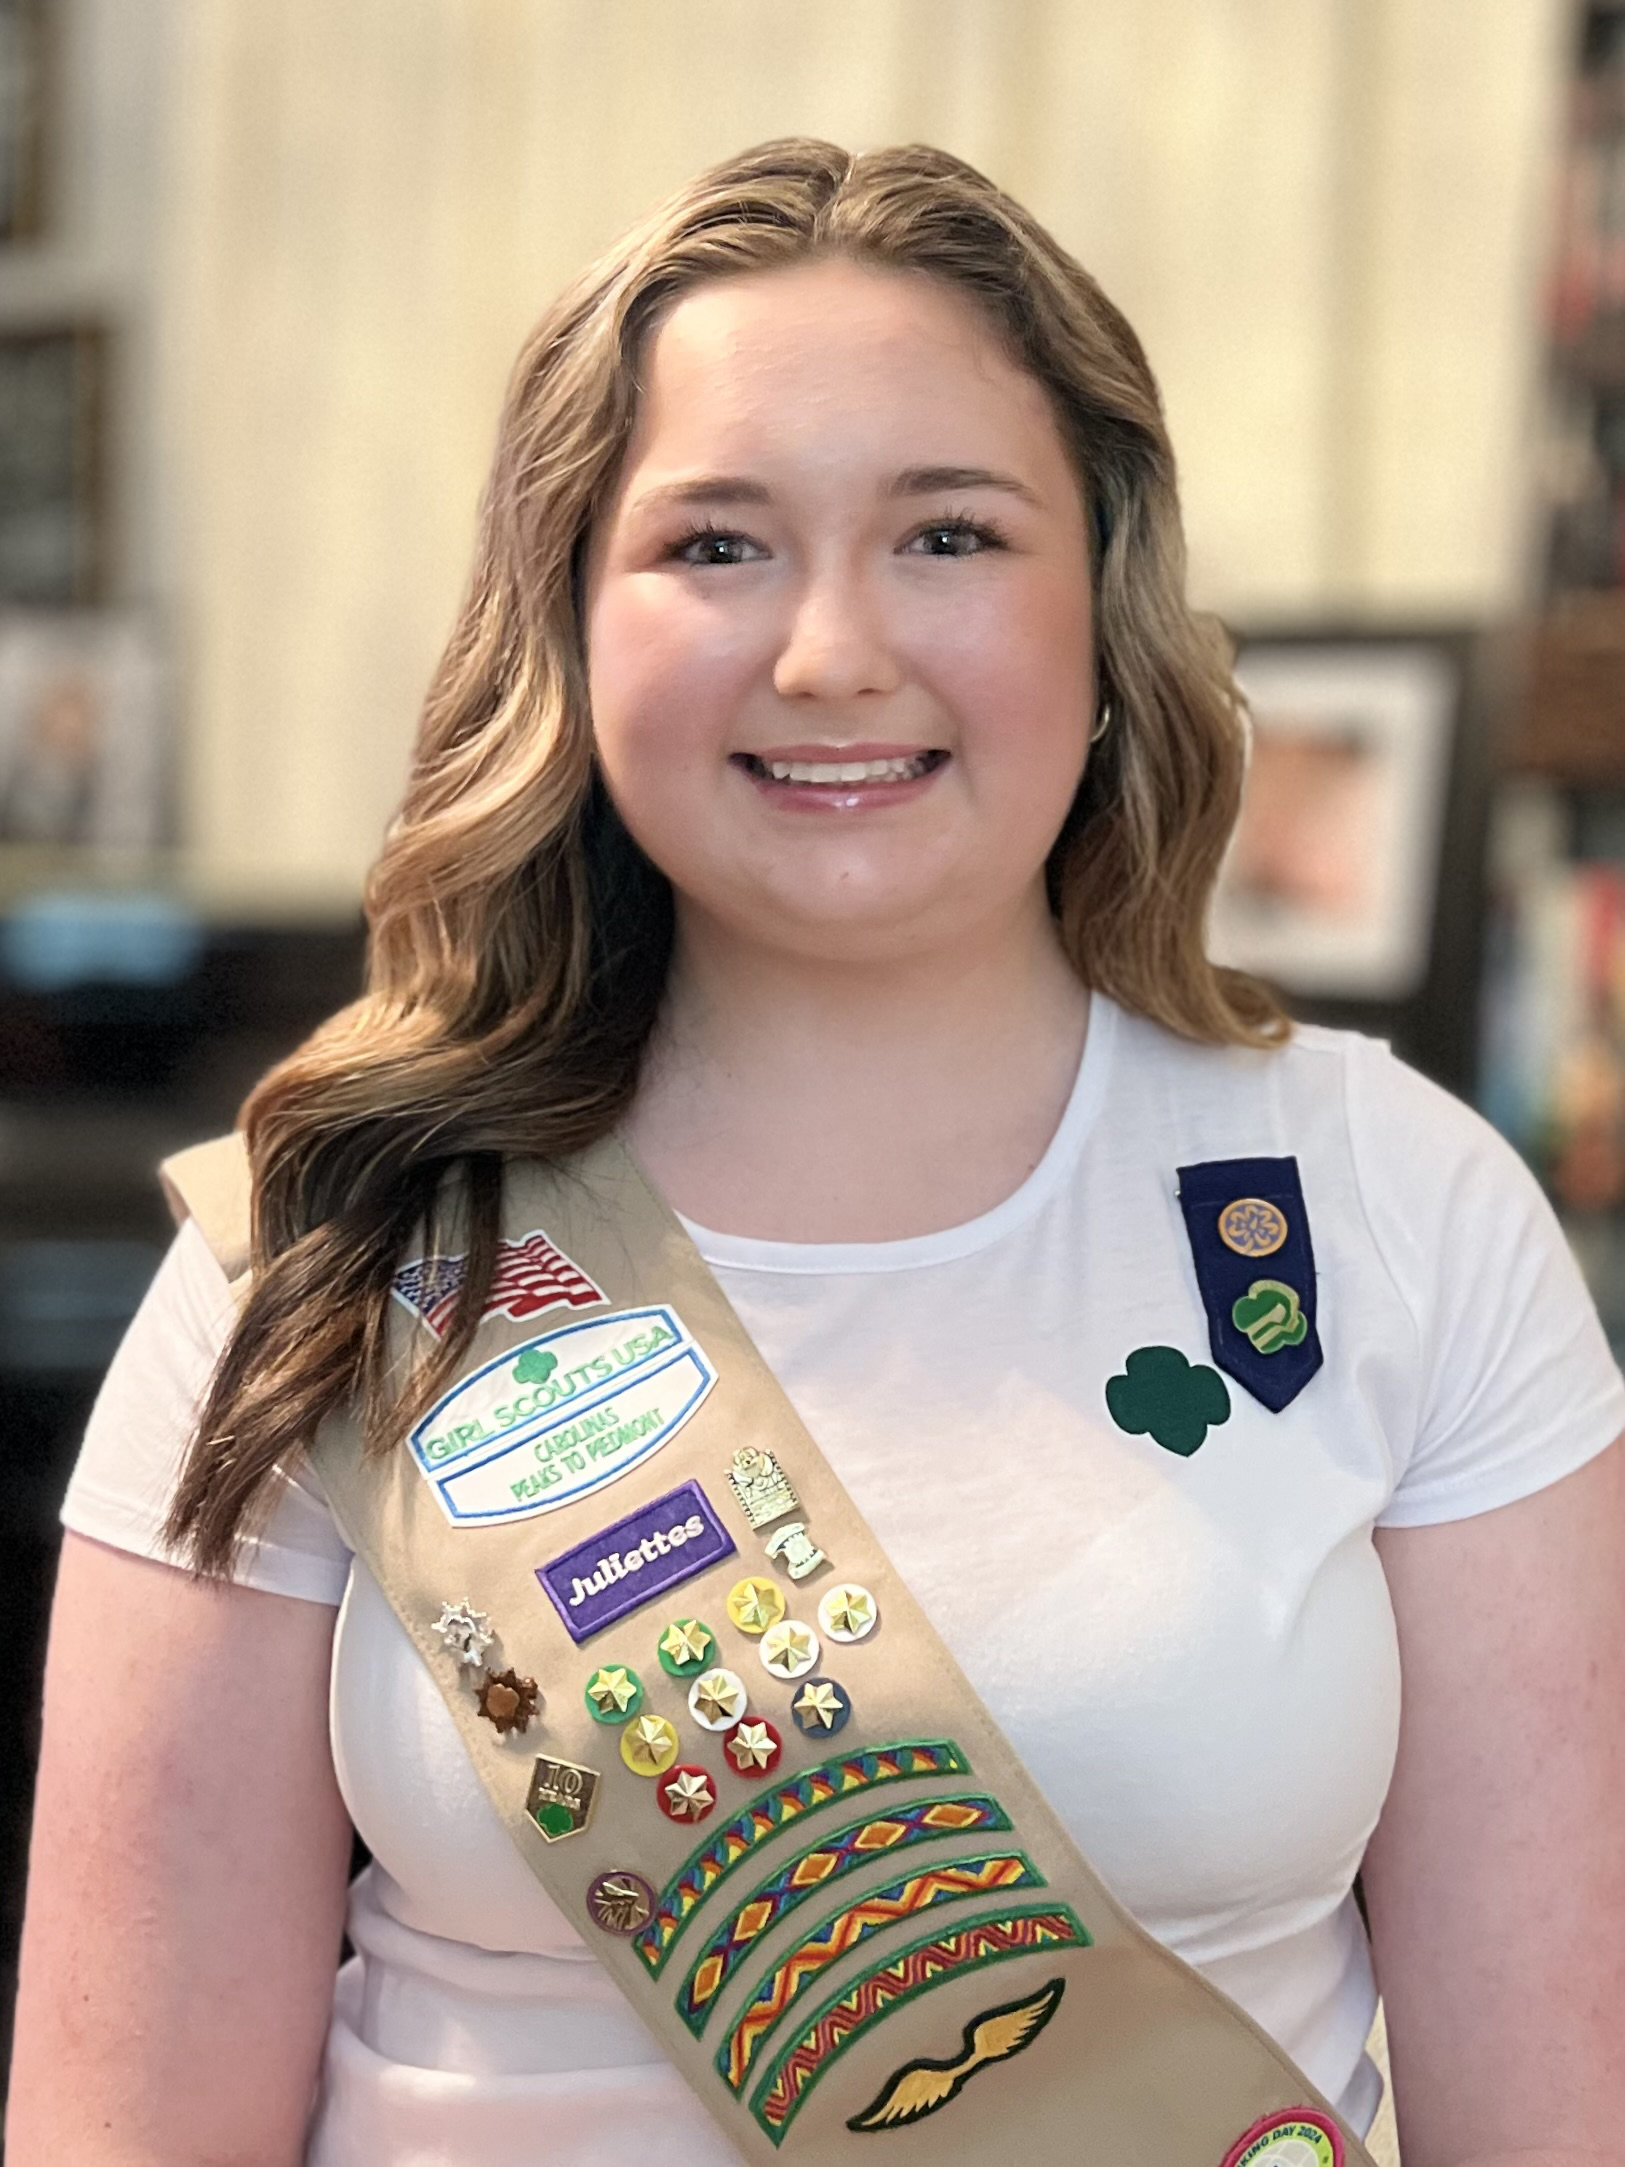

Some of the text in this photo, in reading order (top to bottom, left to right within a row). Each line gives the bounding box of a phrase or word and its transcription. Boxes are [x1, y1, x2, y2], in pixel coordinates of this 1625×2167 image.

[426, 1326, 674, 1460] GIRL SCOUTS USA
[510, 1464, 563, 1502] PEAKS
[560, 1451, 586, 1474] TO
[569, 1515, 705, 1607] Juliettes
[544, 1764, 583, 1795] 10
[1238, 2125, 1323, 2167] KING DAY 2024
